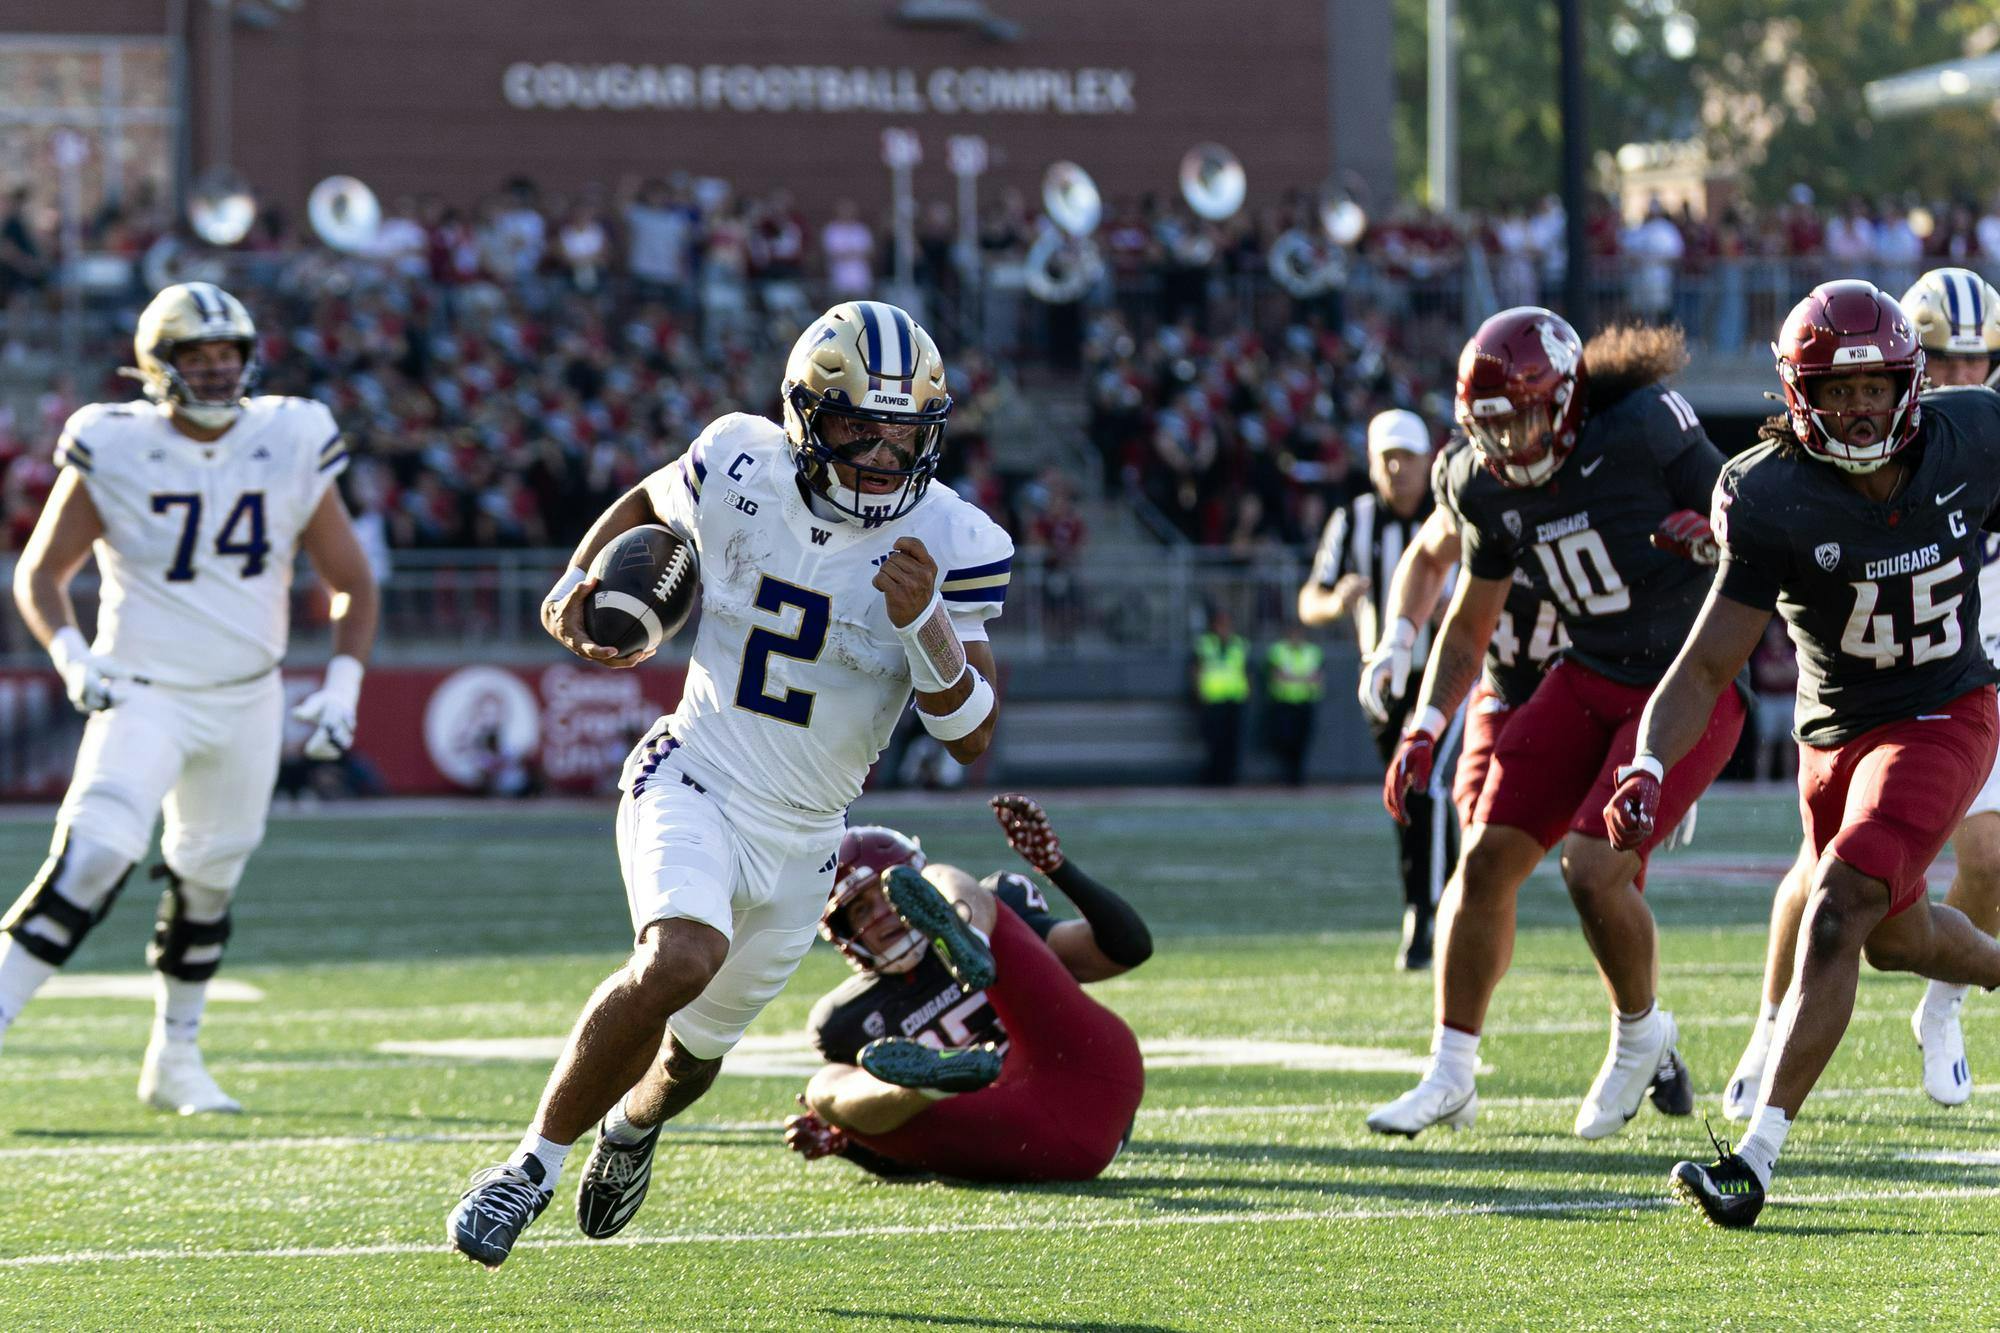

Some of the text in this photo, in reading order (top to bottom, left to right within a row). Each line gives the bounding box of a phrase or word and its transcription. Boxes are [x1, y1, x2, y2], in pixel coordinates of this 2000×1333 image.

[504, 62, 1135, 114] COUGAR FOOTBALL COMPLEX
[1849, 348, 1868, 359] WSU
[874, 394, 909, 407] DAWGS
[727, 452, 754, 482] C
[149, 489, 273, 582] 74
[810, 526, 833, 546] W
[1536, 511, 1590, 543] COUGARS
[1948, 509, 1967, 539] C
[1533, 529, 1631, 617] 10
[1865, 543, 1941, 580] COUGARS
[1840, 556, 1964, 670] 45
[732, 572, 833, 729] 2
[901, 983, 961, 1037] COUGARS
